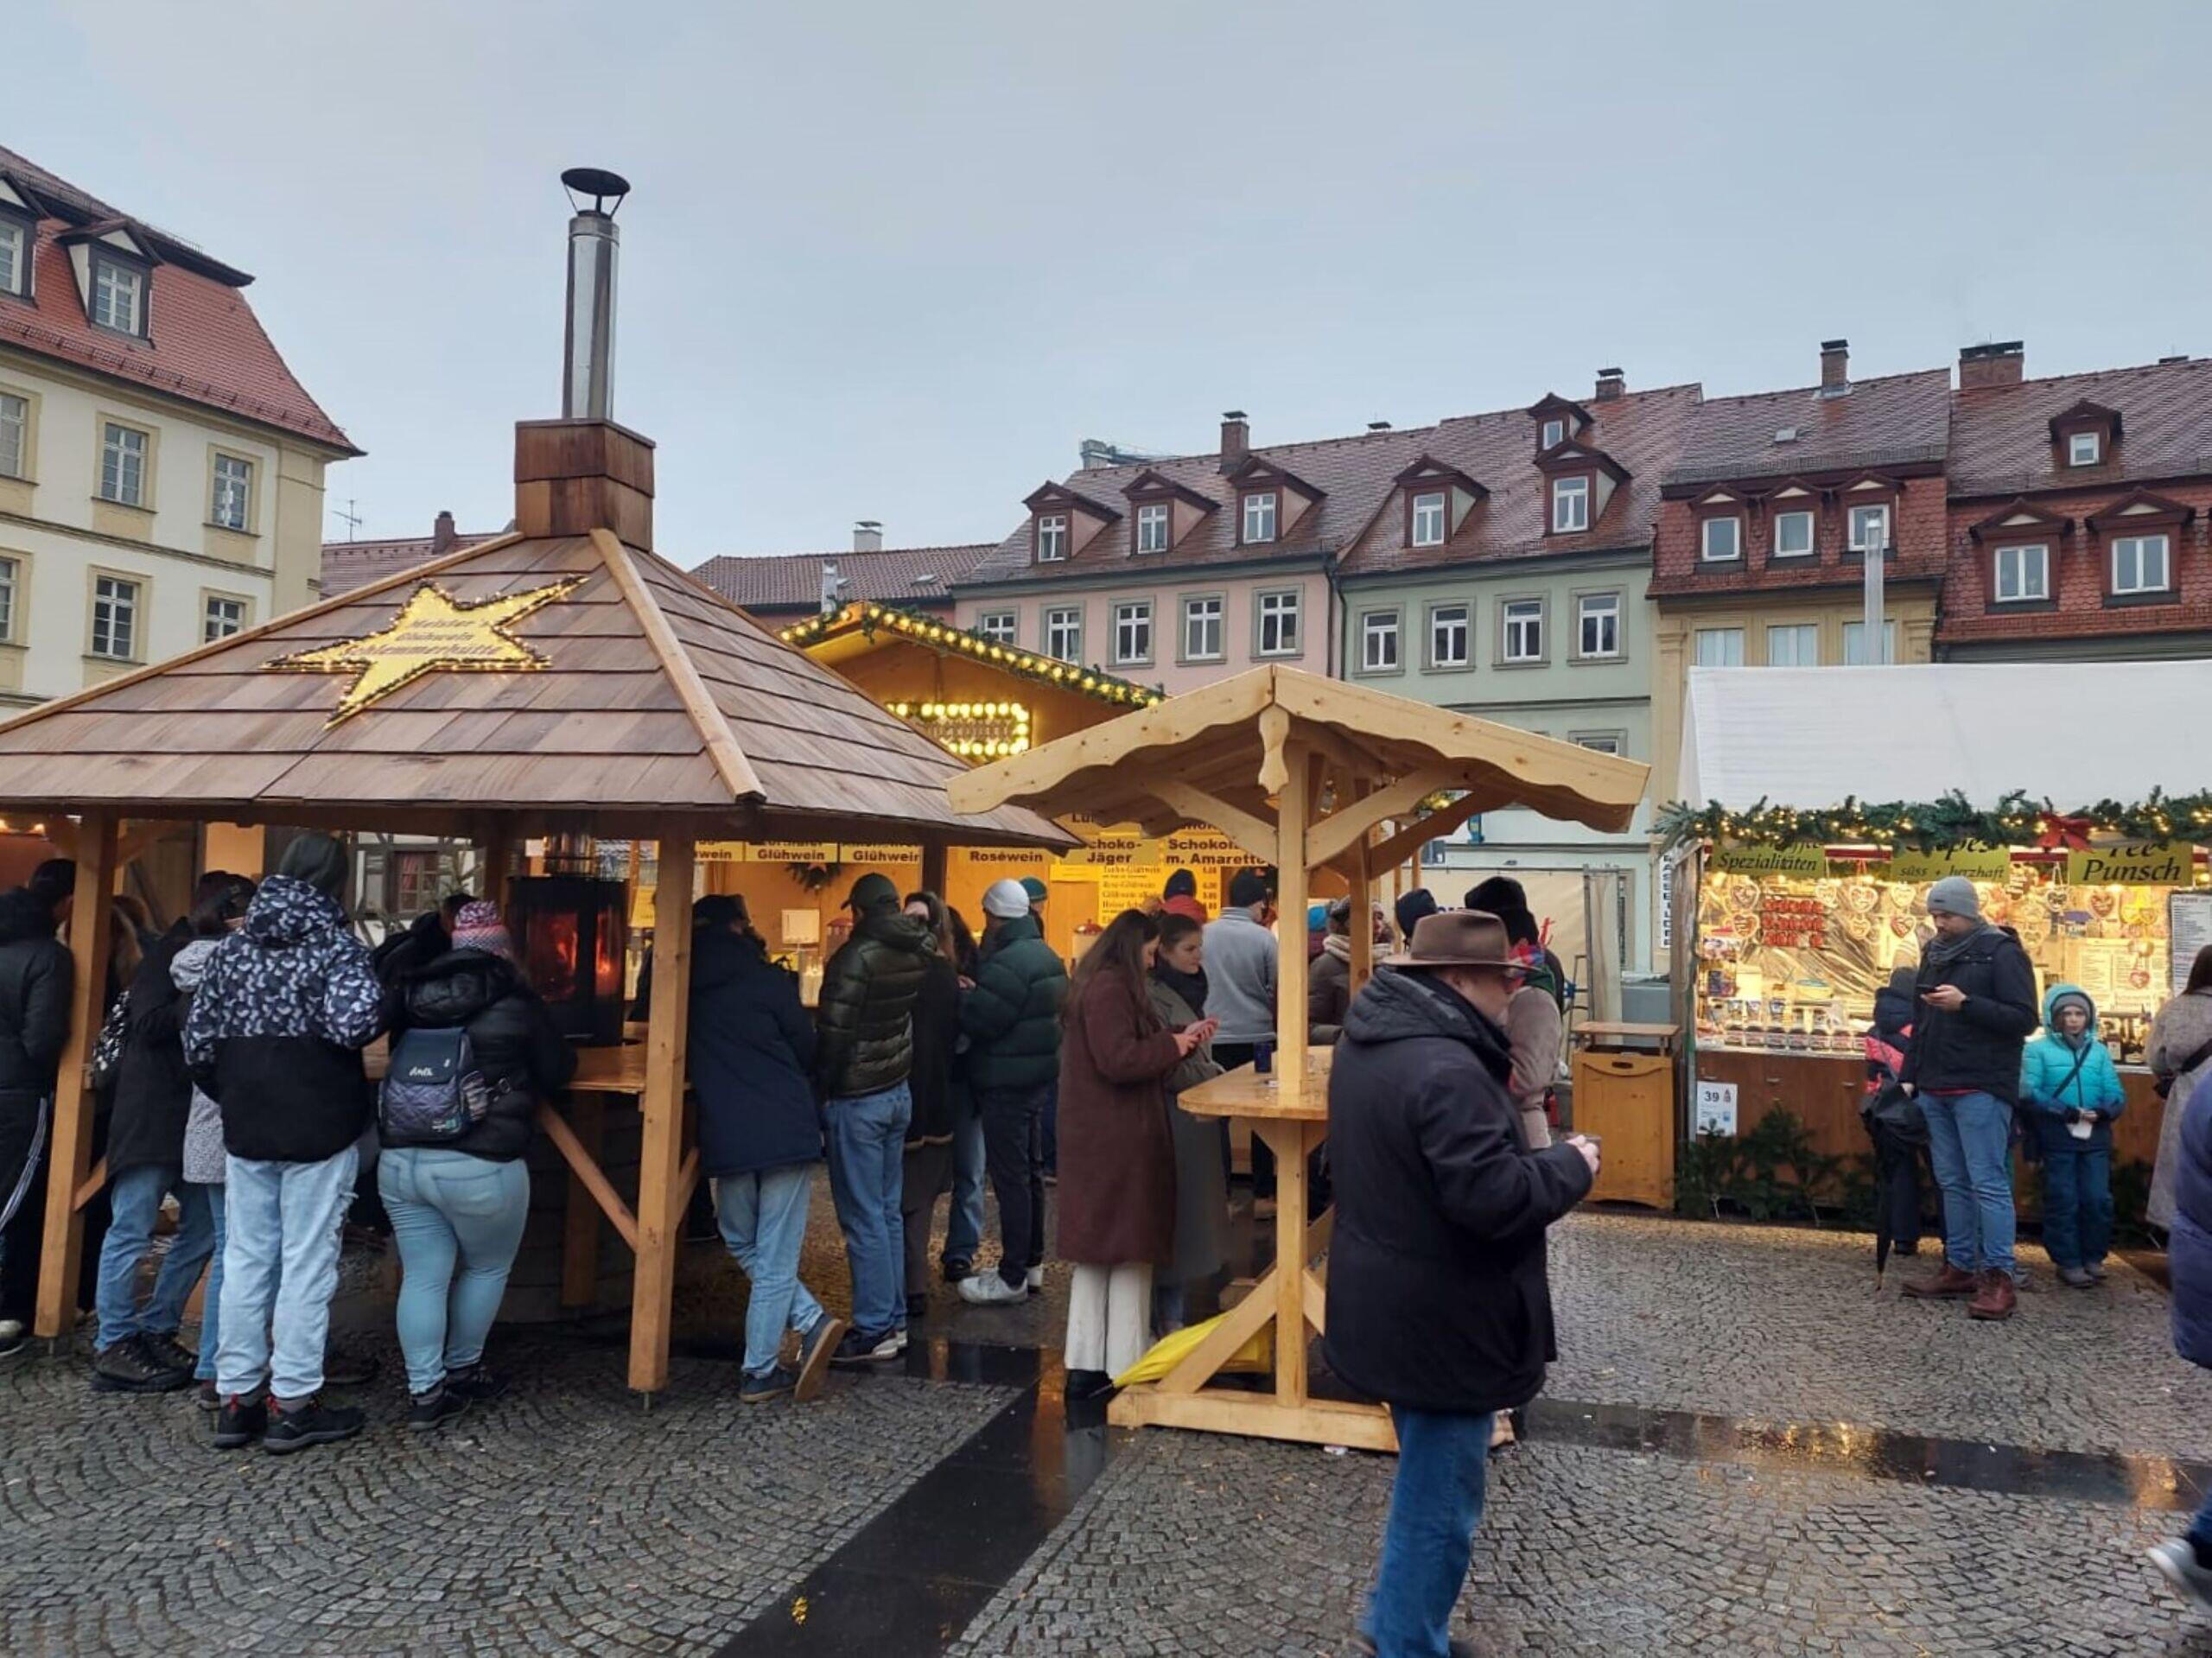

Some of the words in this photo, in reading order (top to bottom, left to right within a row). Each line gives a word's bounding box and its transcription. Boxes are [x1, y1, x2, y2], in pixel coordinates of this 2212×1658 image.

[1169, 837, 1239, 850] Schokol
[758, 848, 824, 860] Glühwein
[970, 850, 1043, 863] Roséwein
[1087, 851, 1133, 866] Jäger
[1718, 852, 1817, 873] Spezialitäten
[2082, 857, 2181, 881] Punsch
[1703, 1090, 1719, 1102] 39
